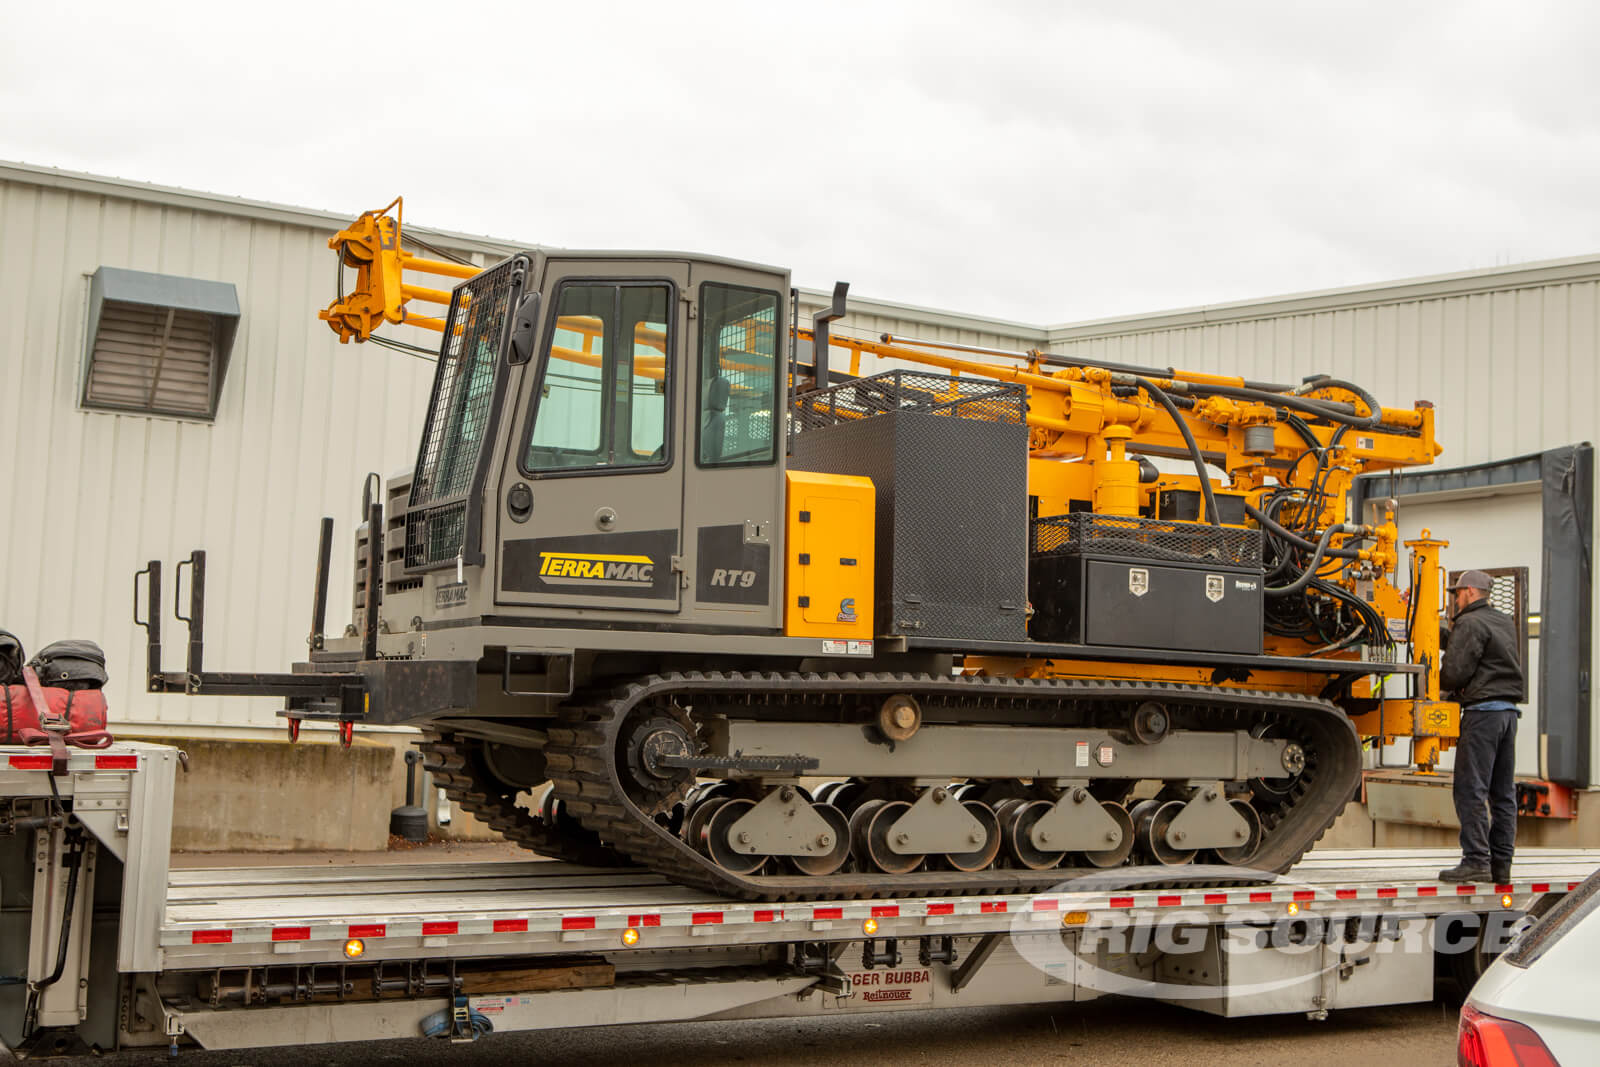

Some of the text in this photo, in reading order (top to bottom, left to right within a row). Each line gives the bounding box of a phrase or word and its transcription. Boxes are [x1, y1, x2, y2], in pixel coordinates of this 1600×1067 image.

[539, 552, 654, 581] TERRAMAC
[711, 568, 756, 588] RT9
[848, 970, 930, 986] GER BUBBA
